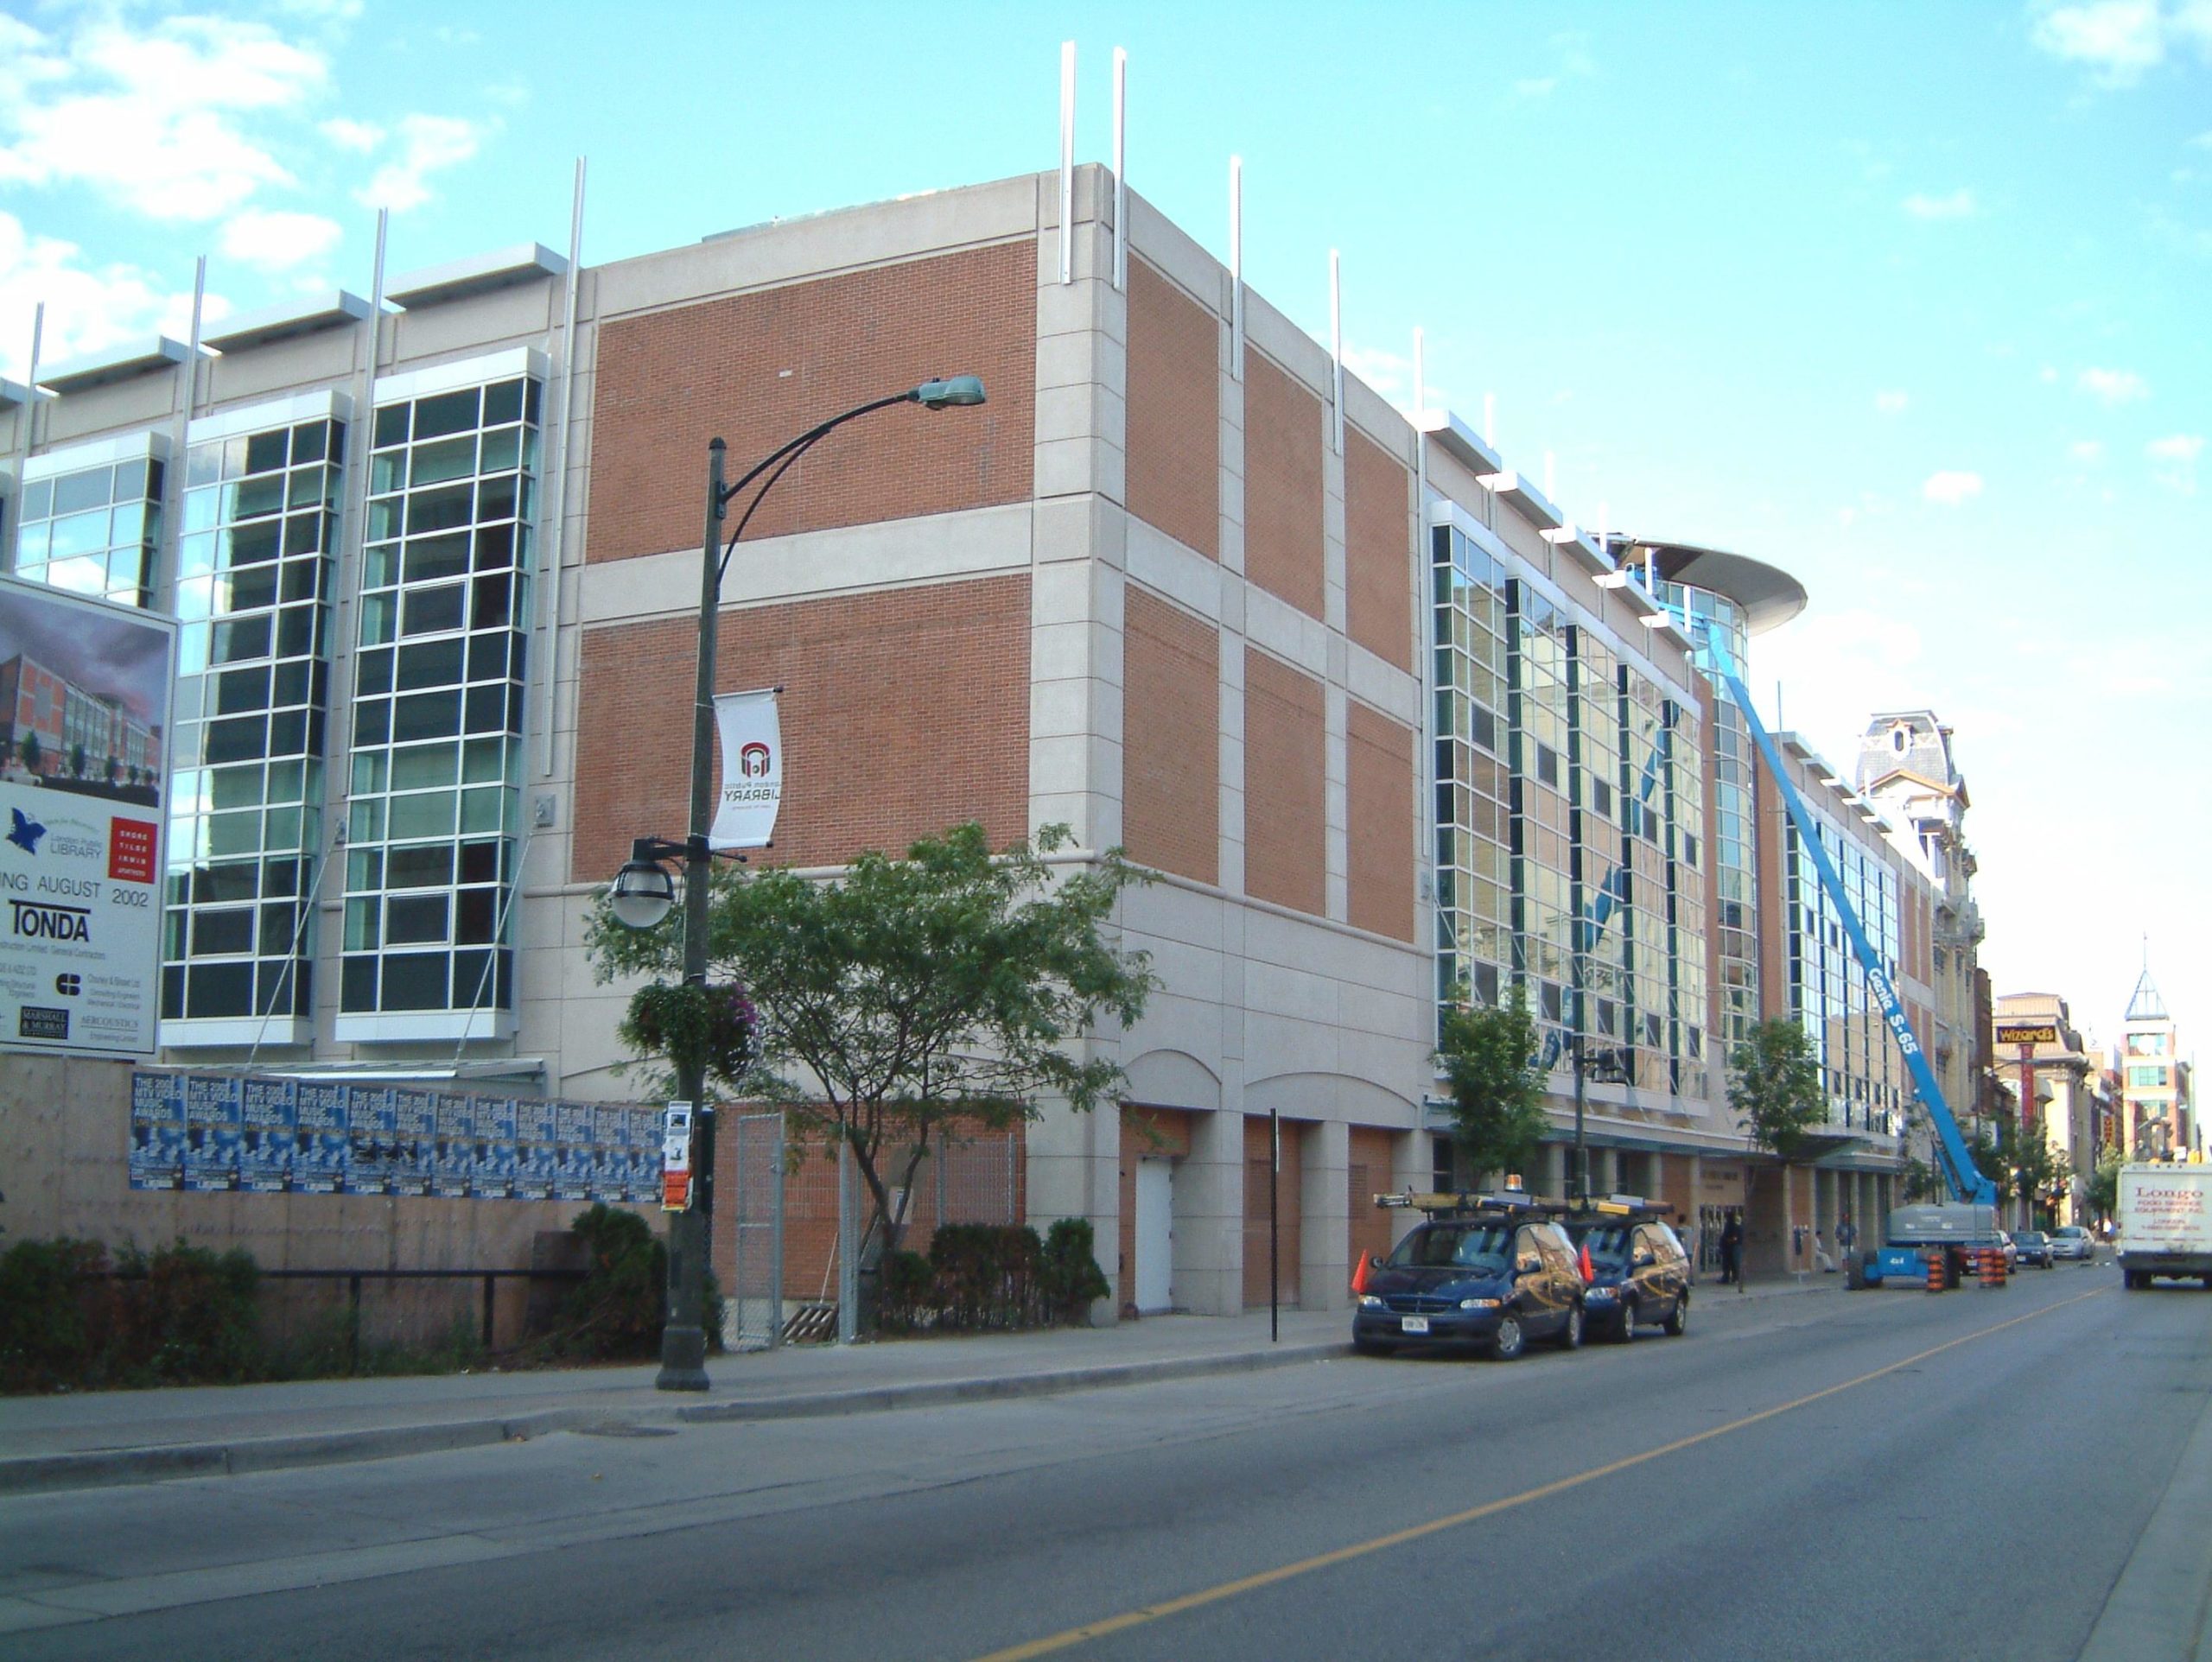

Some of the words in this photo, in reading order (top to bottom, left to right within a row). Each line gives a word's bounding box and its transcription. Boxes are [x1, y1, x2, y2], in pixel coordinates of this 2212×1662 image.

[50, 842, 102, 860] LIBRARY
[37, 876, 101, 898] AUGUST
[112, 888, 148, 907] 2002
[9, 898, 91, 942] TONDA
[1869, 968, 1894, 1010] Genie
[2136, 1186, 2204, 1200] Longo
